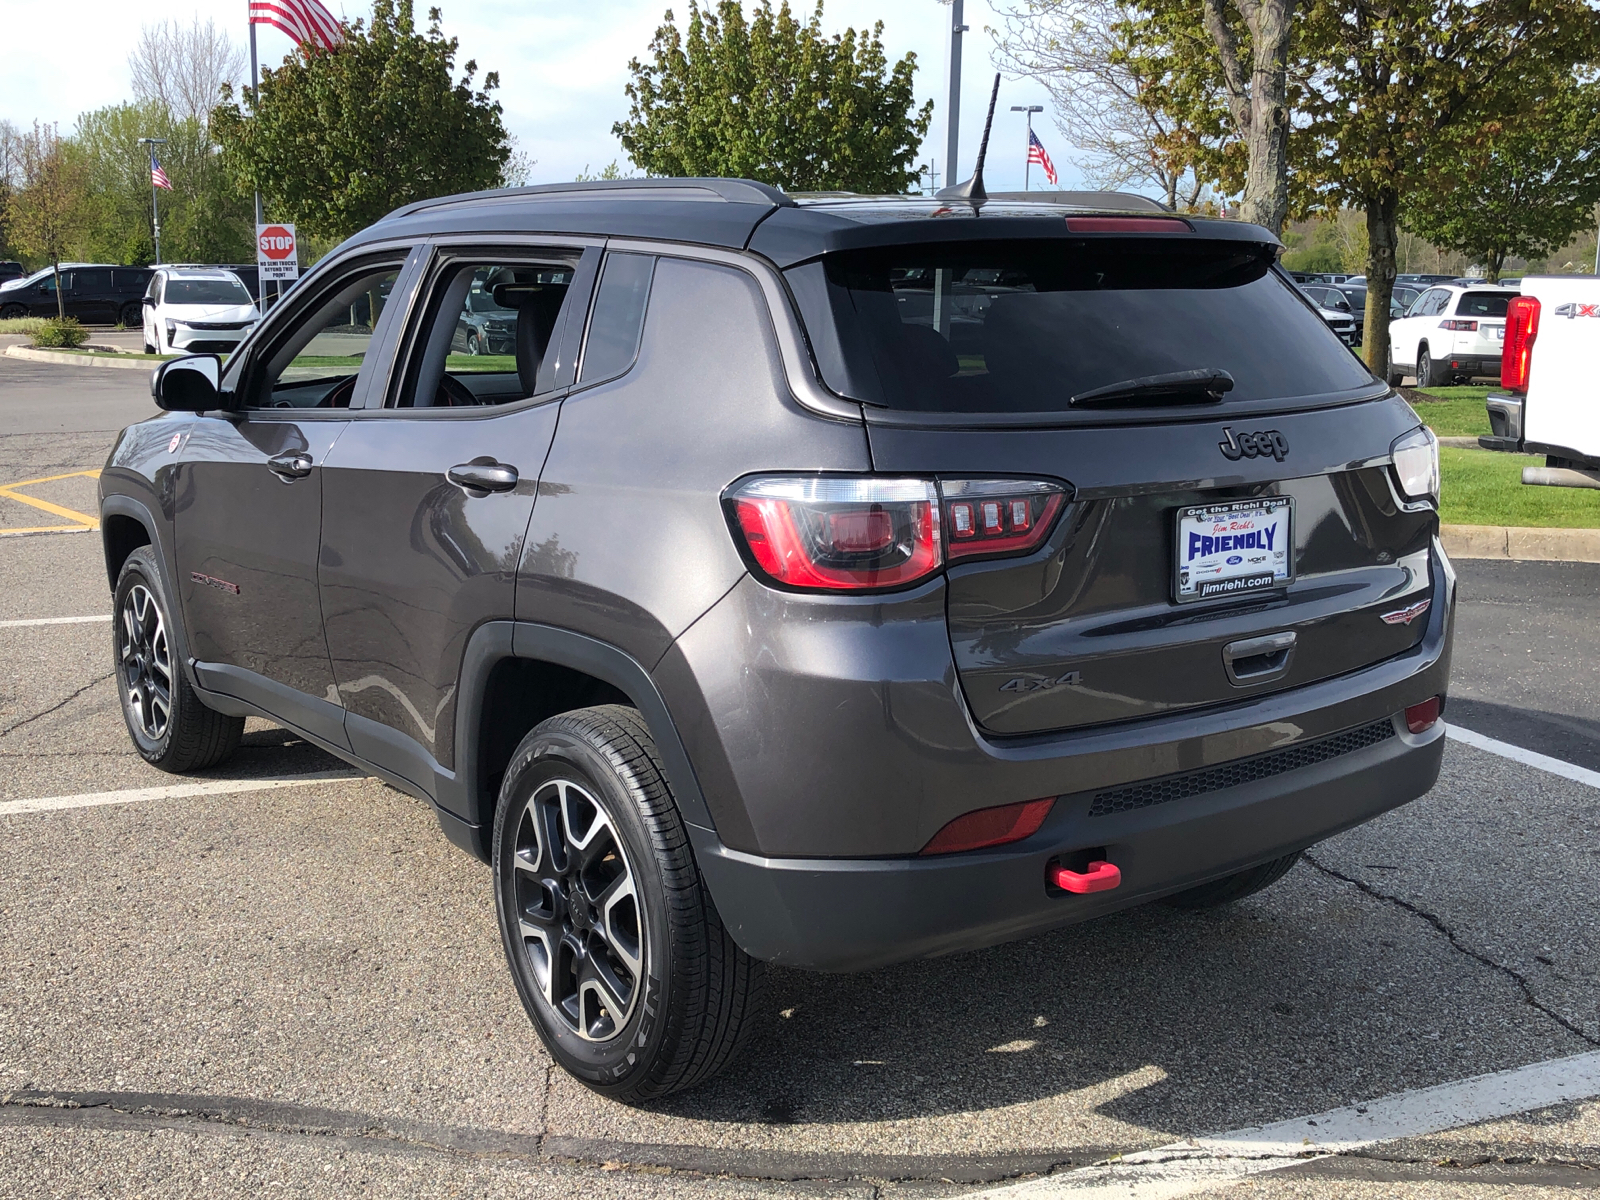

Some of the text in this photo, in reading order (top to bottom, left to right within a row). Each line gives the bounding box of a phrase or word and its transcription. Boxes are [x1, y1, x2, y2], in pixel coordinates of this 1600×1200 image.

[260, 236, 293, 250] STOP
[1218, 426, 1289, 463] Jeep
[1187, 508, 1207, 516] Get
[1231, 502, 1260, 511] Riehl
[1262, 499, 1287, 508] Deal
[1212, 520, 1255, 536] Jim Riehl's
[1188, 521, 1277, 561] FRIENDLY
[1228, 556, 1241, 564] Ford
[1201, 576, 1272, 597] jimriehl.com
[998, 670, 1083, 693] 4x4
[597, 975, 661, 1084] NEXEN
